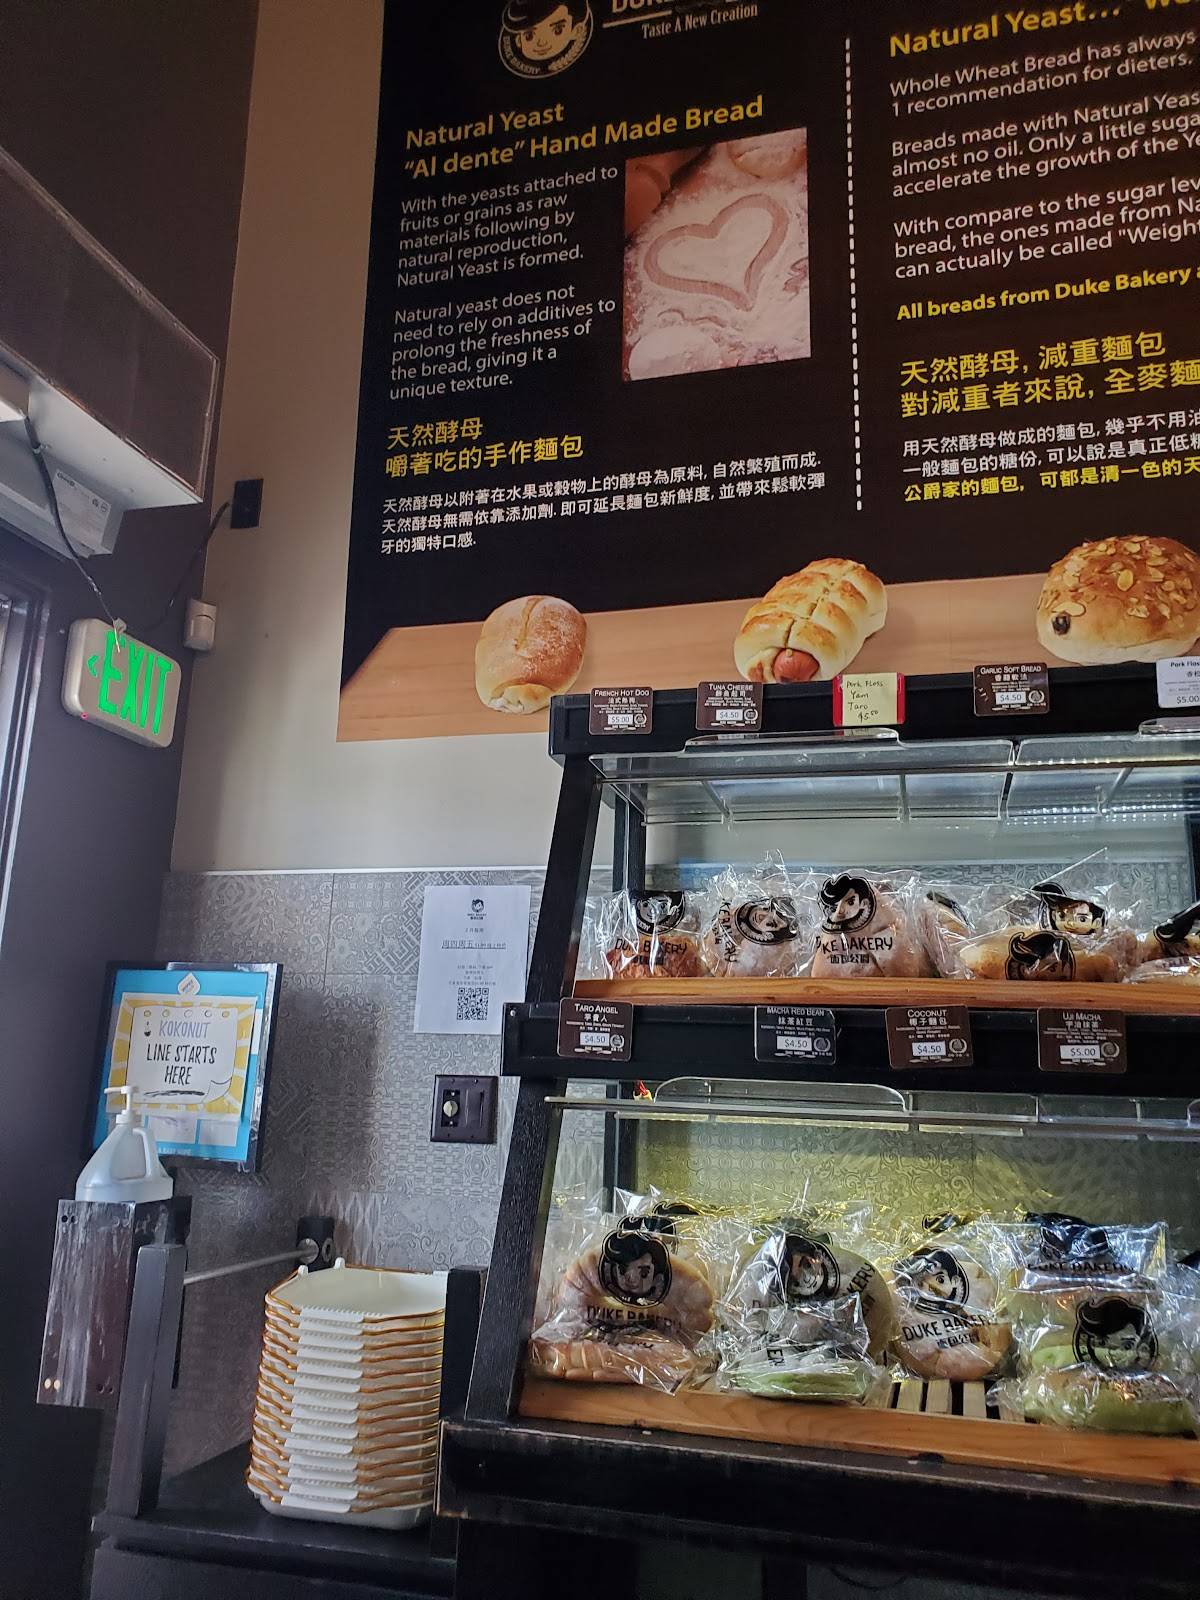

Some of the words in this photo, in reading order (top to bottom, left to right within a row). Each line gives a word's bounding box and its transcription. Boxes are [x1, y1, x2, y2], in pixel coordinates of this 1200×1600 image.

[641, 22, 672, 39] Taste
[675, 19, 682, 33] A
[684, 15, 708, 31] New
[711, 4, 758, 25] Creation
[889, 15, 998, 57] Natural
[890, 72, 951, 97] Whole
[955, 60, 1019, 85] Wheat
[1024, 47, 1081, 73] Bread
[1087, 41, 1122, 61] has
[1126, 30, 1196, 54] always
[892, 103, 899, 118] 1
[907, 71, 1077, 114] recommendation
[1083, 63, 1111, 83] for
[1116, 51, 1193, 76] dieters.
[406, 115, 494, 150] Natural
[500, 102, 565, 132] Yeast
[530, 126, 597, 159] Hand
[604, 114, 677, 145] Made
[685, 95, 763, 131] Bread
[892, 131, 956, 157] Breads
[962, 119, 1018, 145] made
[1023, 111, 1068, 135] with
[1074, 97, 1149, 125] Natural
[892, 152, 958, 177] almost
[963, 148, 989, 165] no
[994, 140, 1023, 160] oil.
[1029, 131, 1077, 157] Only
[1081, 130, 1093, 145] a
[1099, 118, 1146, 143] little
[892, 163, 992, 198] accelerate
[997, 159, 1031, 180] the
[1036, 142, 1111, 177] growth
[1116, 140, 1138, 160] of
[1143, 134, 1180, 156] the
[401, 196, 437, 215] With
[441, 192, 467, 208] the
[471, 183, 520, 206] yeasts
[524, 167, 596, 194] attached
[600, 166, 618, 180] to
[893, 216, 939, 238] With
[944, 201, 1034, 233] compare
[1039, 198, 1061, 215] to
[1065, 191, 1101, 212] the
[1106, 178, 1166, 209] sugar
[399, 226, 470, 250] materials
[474, 214, 550, 239] following
[554, 210, 575, 226] by
[400, 214, 439, 233] fruits
[443, 212, 460, 225] or
[464, 201, 512, 226] grains
[516, 200, 533, 214] as
[537, 193, 568, 211] raw
[894, 234, 957, 259] bread,
[961, 230, 995, 250] the
[1000, 224, 1049, 244] ones
[1055, 211, 1115, 234] made
[1119, 201, 1172, 224] from
[397, 265, 454, 288] Natural
[458, 259, 499, 278] Yeast
[503, 257, 515, 271] is
[519, 244, 584, 269] formed.
[398, 247, 453, 269] natural
[457, 230, 568, 262] reproduction,
[895, 262, 930, 279] can
[935, 248, 1013, 274] actually
[1019, 244, 1046, 262] be
[1050, 232, 1112, 256] called
[395, 302, 452, 324] Natural
[456, 296, 498, 319] yeast
[502, 291, 542, 309] does
[546, 284, 575, 301] not
[897, 301, 922, 320] All
[927, 293, 997, 317] breads
[1000, 287, 1050, 307] from
[1055, 278, 1111, 300] Duke
[1115, 265, 1192, 291] Bakery
[393, 324, 433, 344] need
[438, 323, 454, 337] to
[458, 316, 488, 336] rely
[491, 316, 513, 329] on
[517, 301, 593, 325] additives
[597, 298, 616, 313] to
[392, 340, 455, 365] prolong
[460, 336, 487, 353] the
[491, 324, 569, 348] freshness
[573, 318, 593, 336] of
[390, 364, 417, 381] the
[421, 356, 472, 377] bread,
[476, 350, 527, 373] giving
[532, 346, 543, 361] it
[547, 346, 557, 359] a
[389, 382, 446, 400] unique
[450, 373, 513, 393] texture.
[387, 416, 484, 451] 天然酵母
[385, 434, 584, 479] 嚼著吃的手作麵包
[98, 629, 173, 736] EXIT
[980, 666, 1002, 675] GARLIC
[1003, 665, 1020, 674] SOFT
[1020, 664, 1042, 673] BREAD
[594, 689, 619, 697] FRENCH
[620, 689, 634, 697] HOT
[635, 688, 650, 696] DOG
[727, 683, 753, 692] CHEESE
[850, 690, 869, 700] Yam
[1000, 693, 1022, 703] $4.50
[1176, 695, 1200, 704] $5.00
[611, 716, 630, 724] $5.00
[719, 711, 739, 719] $4.50
[847, 701, 869, 711] Taro
[574, 1004, 595, 1014] TARO
[595, 1005, 619, 1015] ANGEL
[907, 1009, 947, 1018] COCONUT
[1075, 1012, 1102, 1021] MACHA
[159, 1020, 211, 1039] KOKONUT
[584, 1035, 606, 1044] $4.50
[784, 1038, 808, 1048] $4.50
[147, 1043, 171, 1062] LINE
[174, 1045, 217, 1064] STARTS
[916, 1045, 942, 1054] $4.50
[1070, 1047, 1096, 1057] $5.00
[164, 1065, 193, 1085] HERE
[902, 1321, 942, 1342] DUKE
